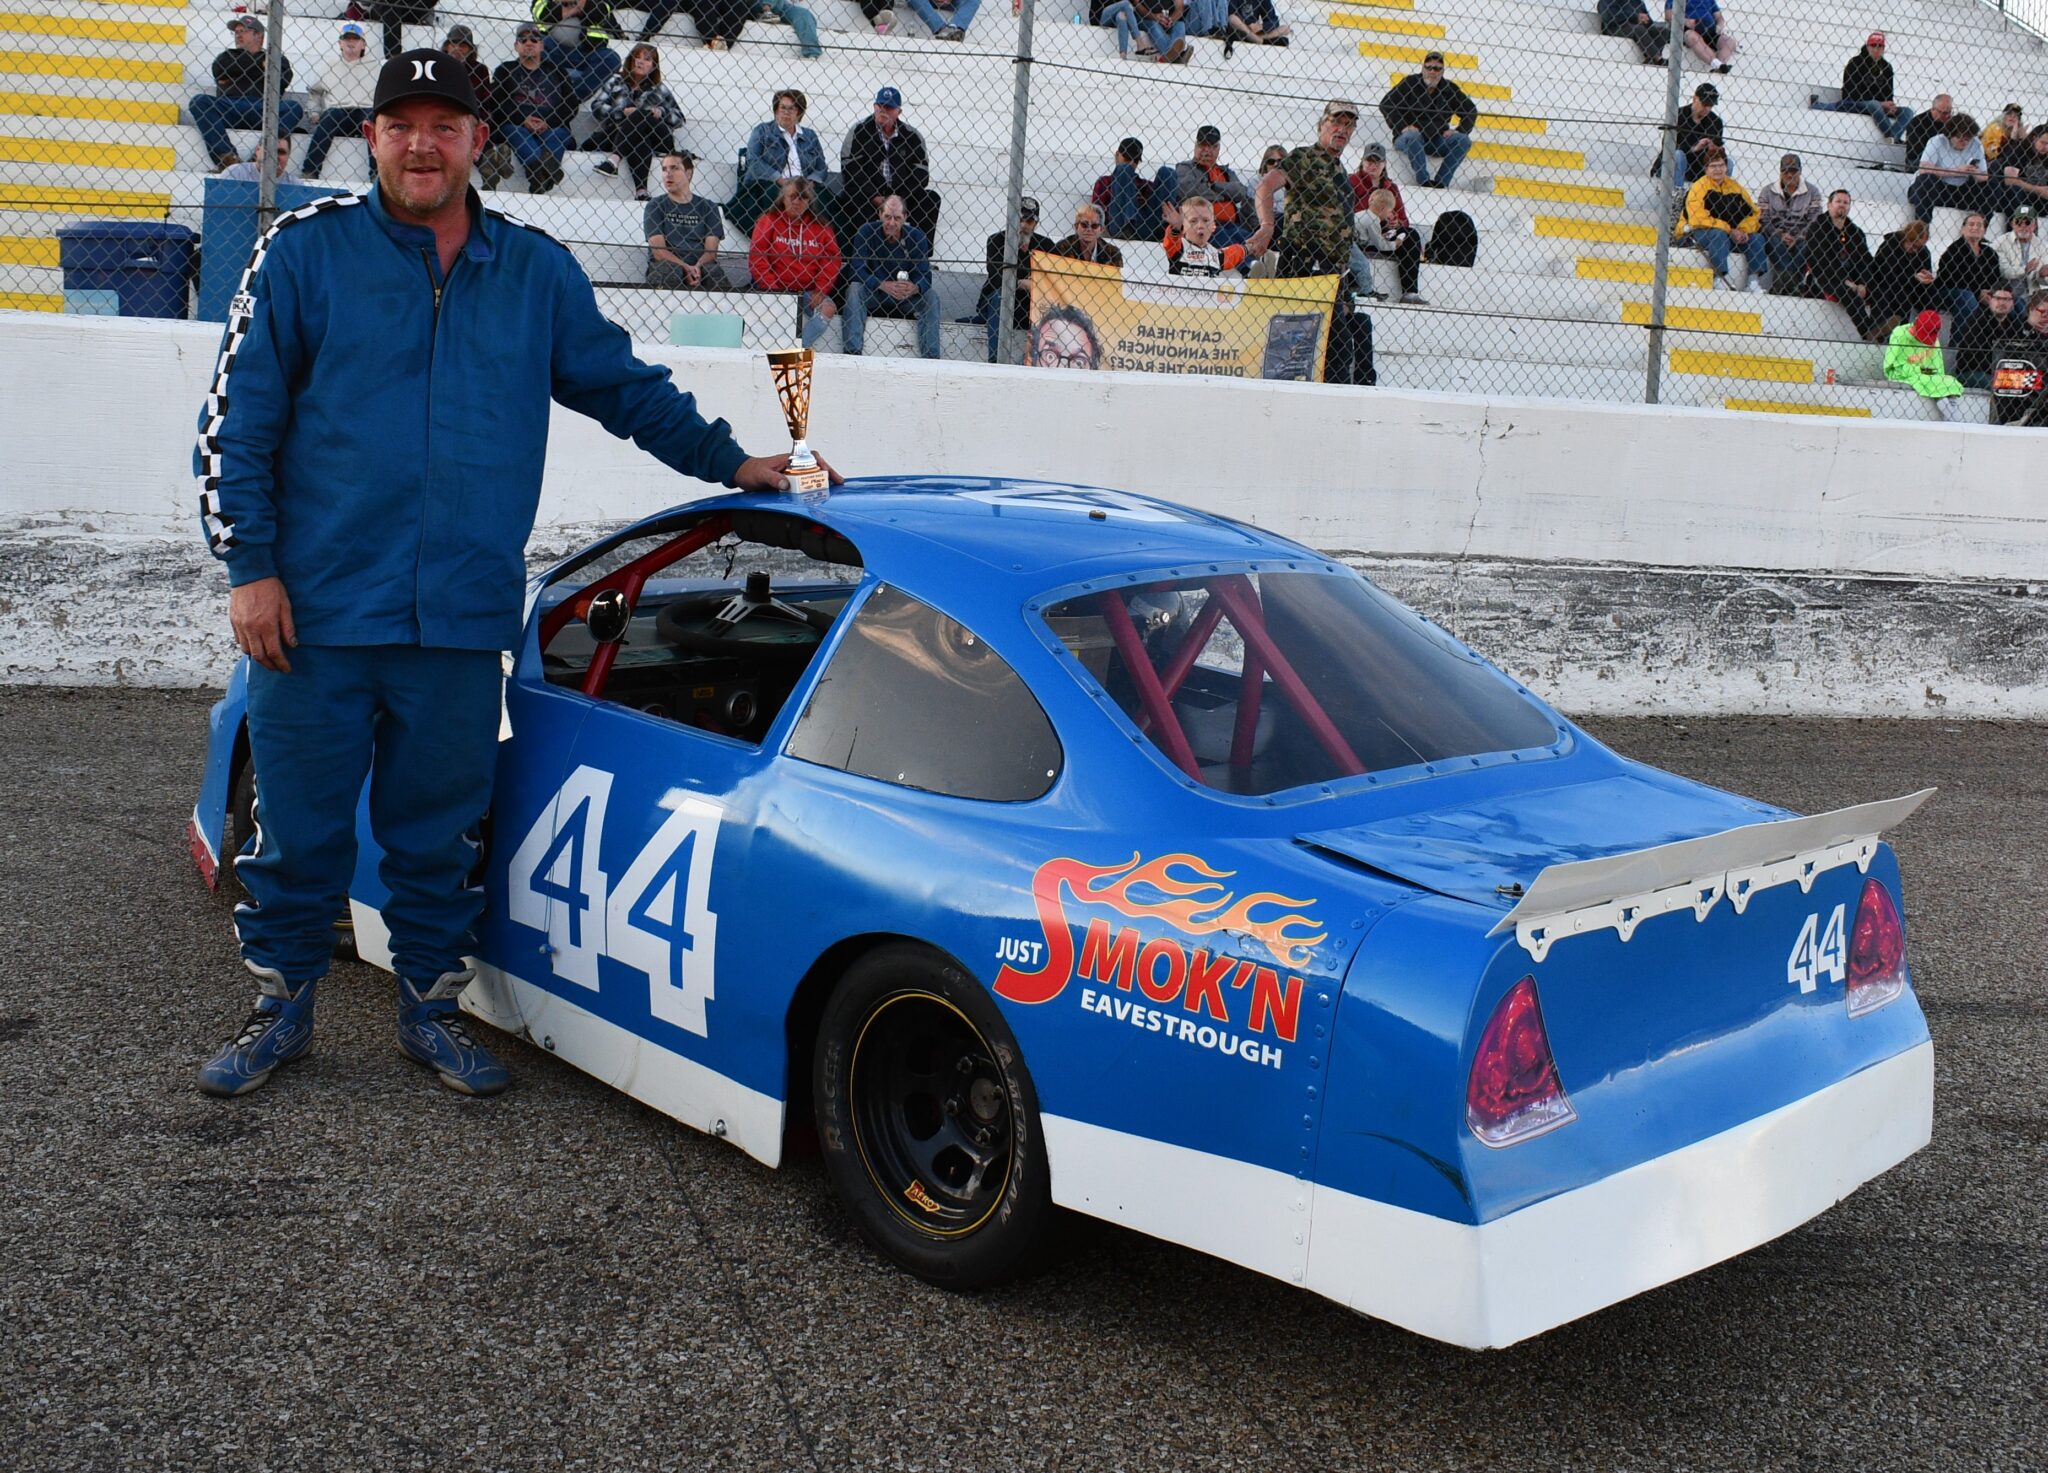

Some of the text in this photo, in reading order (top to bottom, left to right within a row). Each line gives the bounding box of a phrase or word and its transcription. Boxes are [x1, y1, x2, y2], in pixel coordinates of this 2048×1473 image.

[509, 764, 723, 1038] 44
[992, 857, 1304, 1043] JUST SMOK'N
[1788, 903, 1846, 994] 44
[1080, 988, 1283, 1070] EAVESTROUGH
[911, 1189, 934, 1207] AERO
